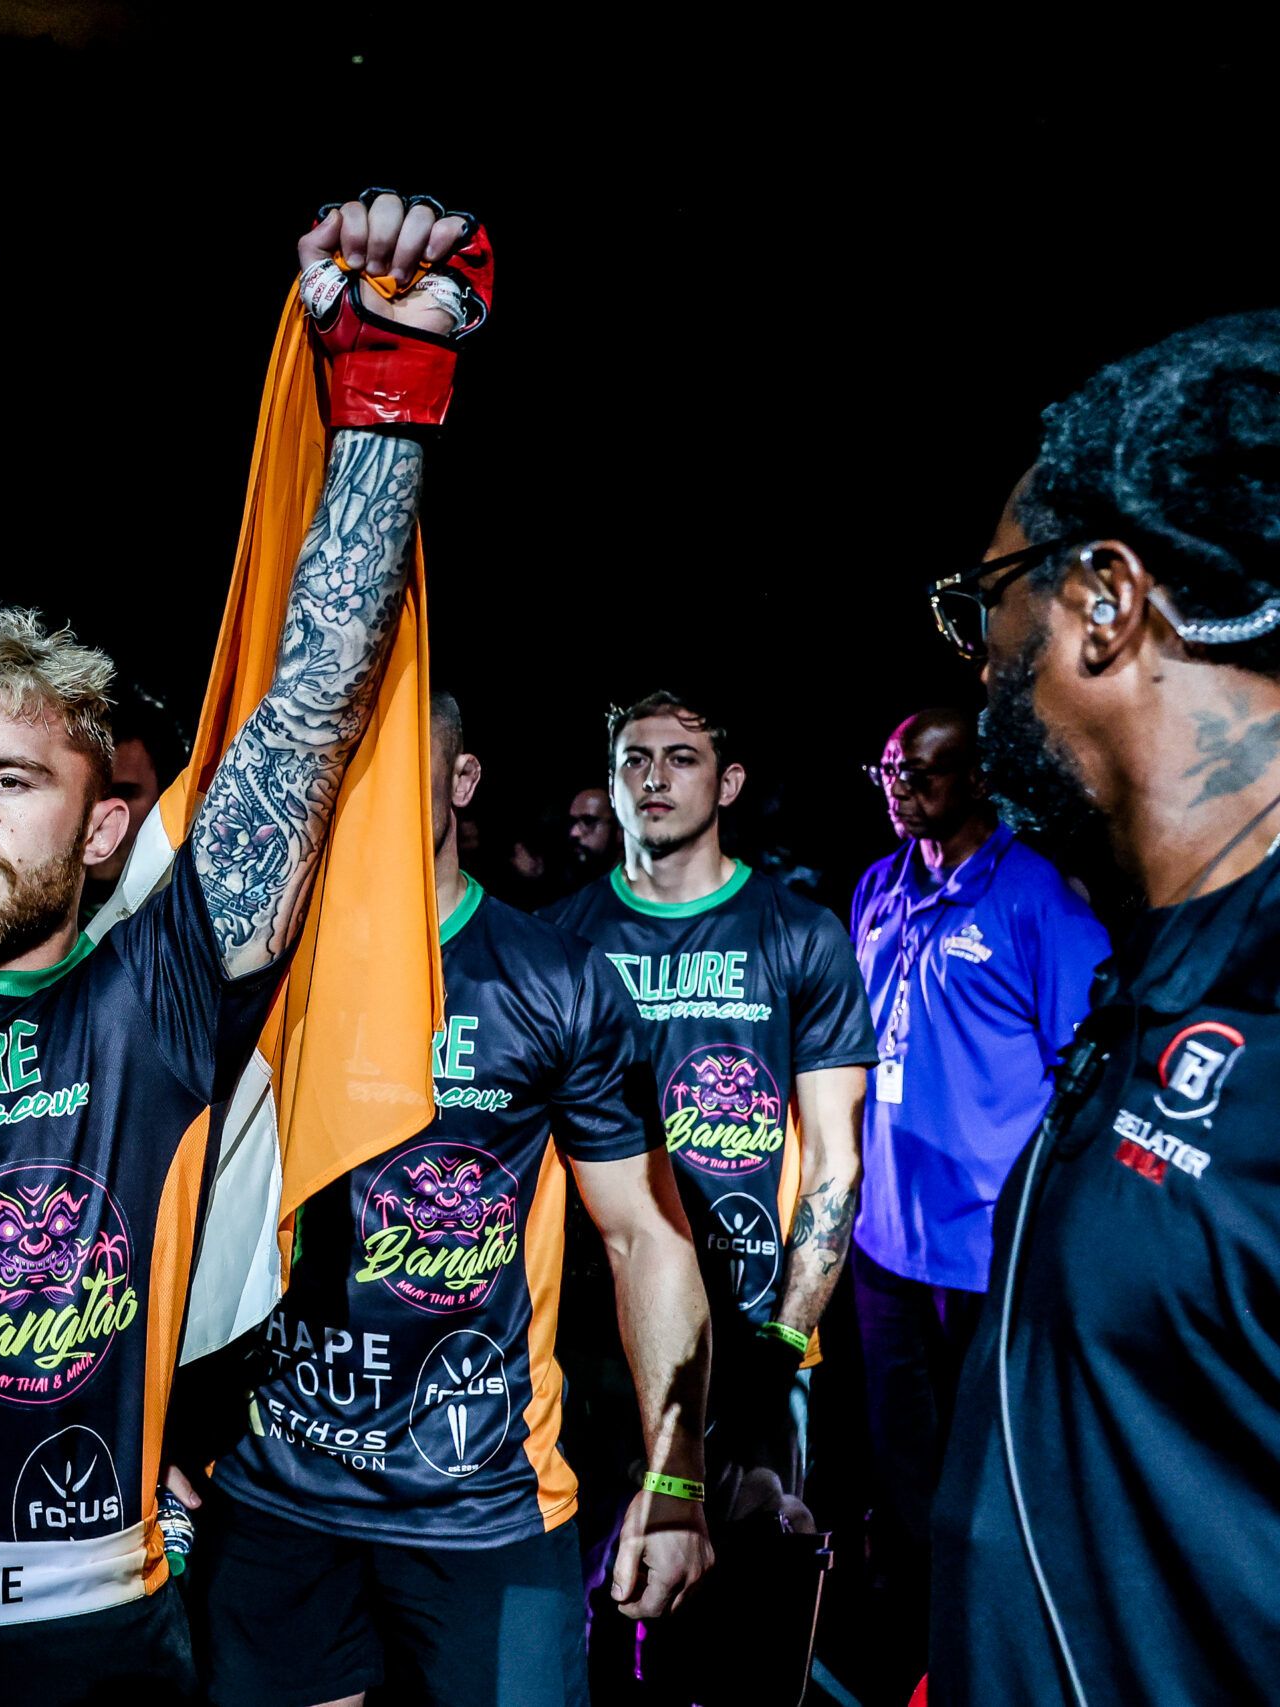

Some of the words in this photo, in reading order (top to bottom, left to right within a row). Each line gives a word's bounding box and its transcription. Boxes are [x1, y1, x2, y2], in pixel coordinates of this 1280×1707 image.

[355, 1221, 518, 1290] Bangtao
[396, 1279, 428, 1300] MUAY
[429, 1293, 455, 1306] THAI
[265, 1311, 392, 1371] HAPE
[16, 1376, 49, 1393] THAI
[66, 1352, 94, 1382] MMA
[271, 1349, 393, 1410] TOUT
[267, 1398, 387, 1450] ETHOS
